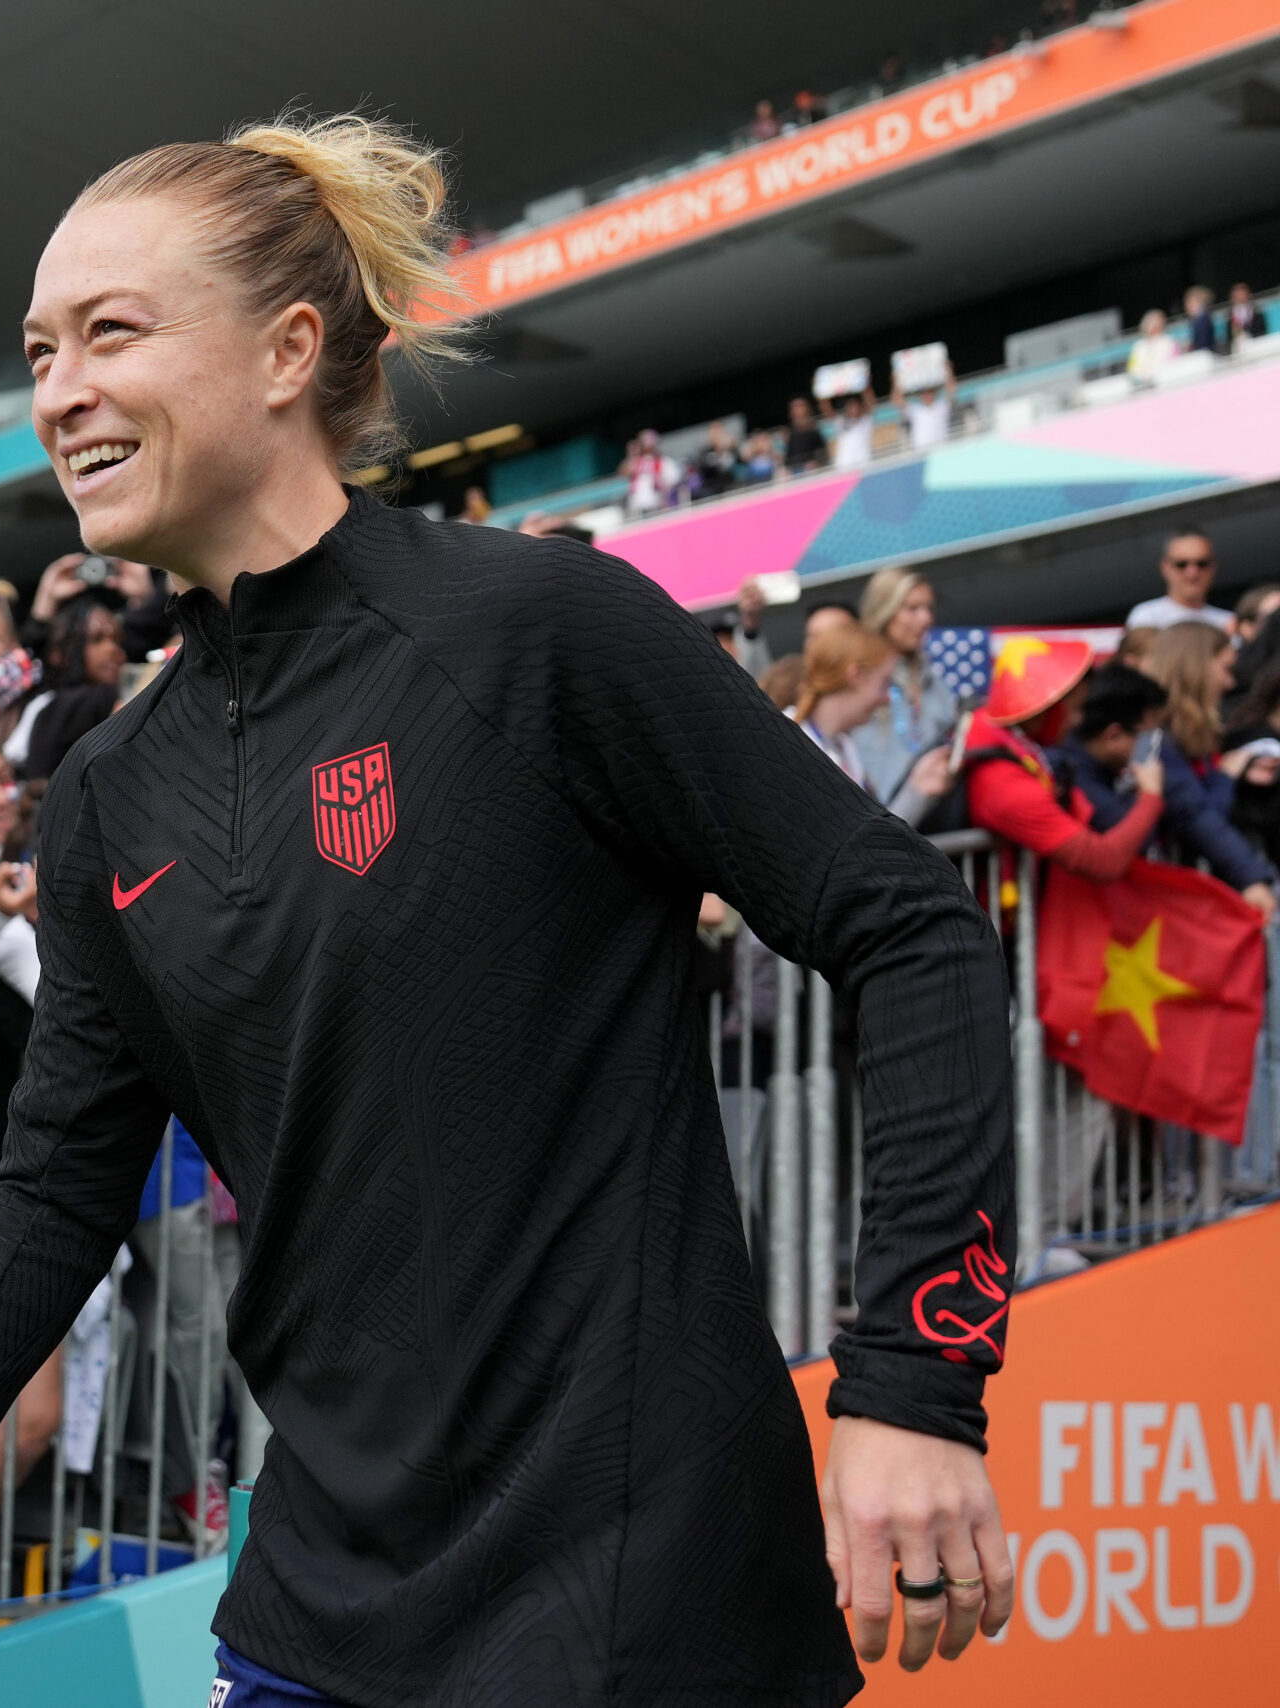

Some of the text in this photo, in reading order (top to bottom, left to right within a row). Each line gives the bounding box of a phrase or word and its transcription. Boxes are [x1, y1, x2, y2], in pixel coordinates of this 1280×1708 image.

[488, 71, 1017, 296] FIFA WOMEN'S WORLD CUP
[319, 752, 385, 806] USA
[1040, 1400, 1217, 1508] FIFA
[986, 1523, 1255, 1645] ORLD
